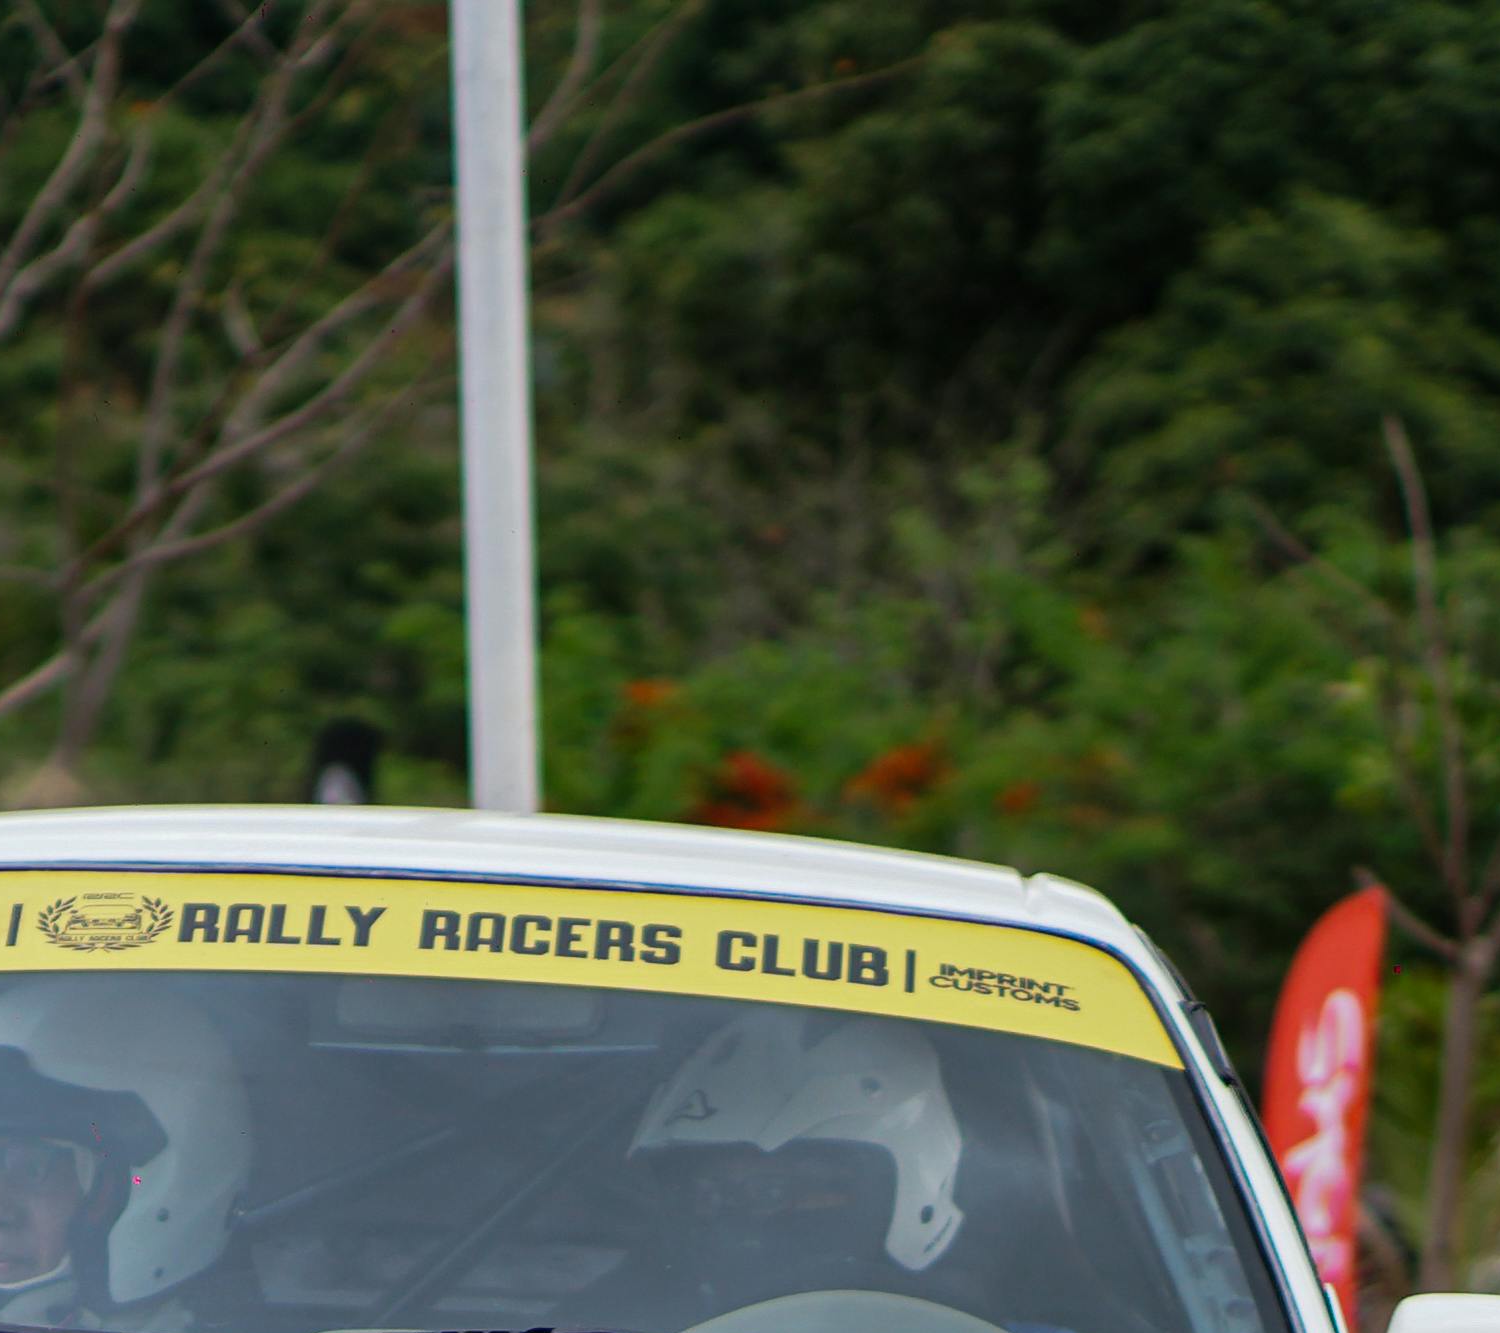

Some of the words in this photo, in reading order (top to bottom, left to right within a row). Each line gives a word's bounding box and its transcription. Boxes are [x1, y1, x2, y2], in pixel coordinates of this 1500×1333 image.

[177, 902, 388, 947] RALLY
[418, 908, 683, 965] RACERS
[715, 929, 890, 987] CLUB
[928, 975, 1081, 1012] CUSTOMS
[939, 962, 1072, 997] IMPRINT
